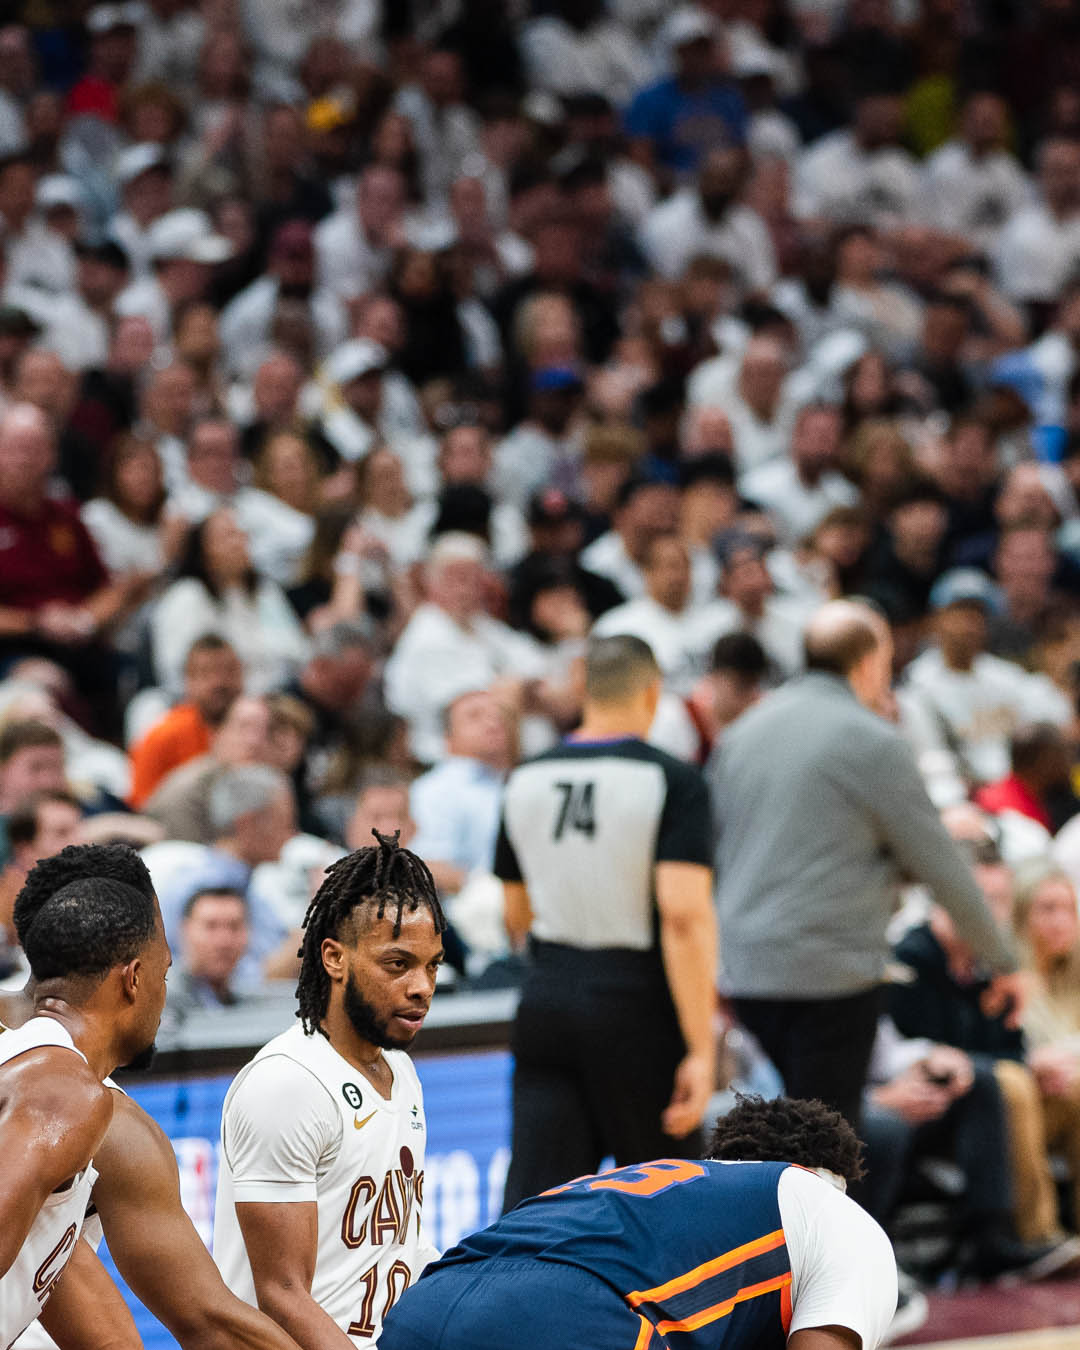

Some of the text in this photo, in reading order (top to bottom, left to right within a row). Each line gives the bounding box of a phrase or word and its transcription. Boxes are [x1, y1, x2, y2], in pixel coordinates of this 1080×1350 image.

[553, 782, 596, 840] 74
[343, 1084, 362, 1109] 6
[347, 1259, 411, 1337] 10
